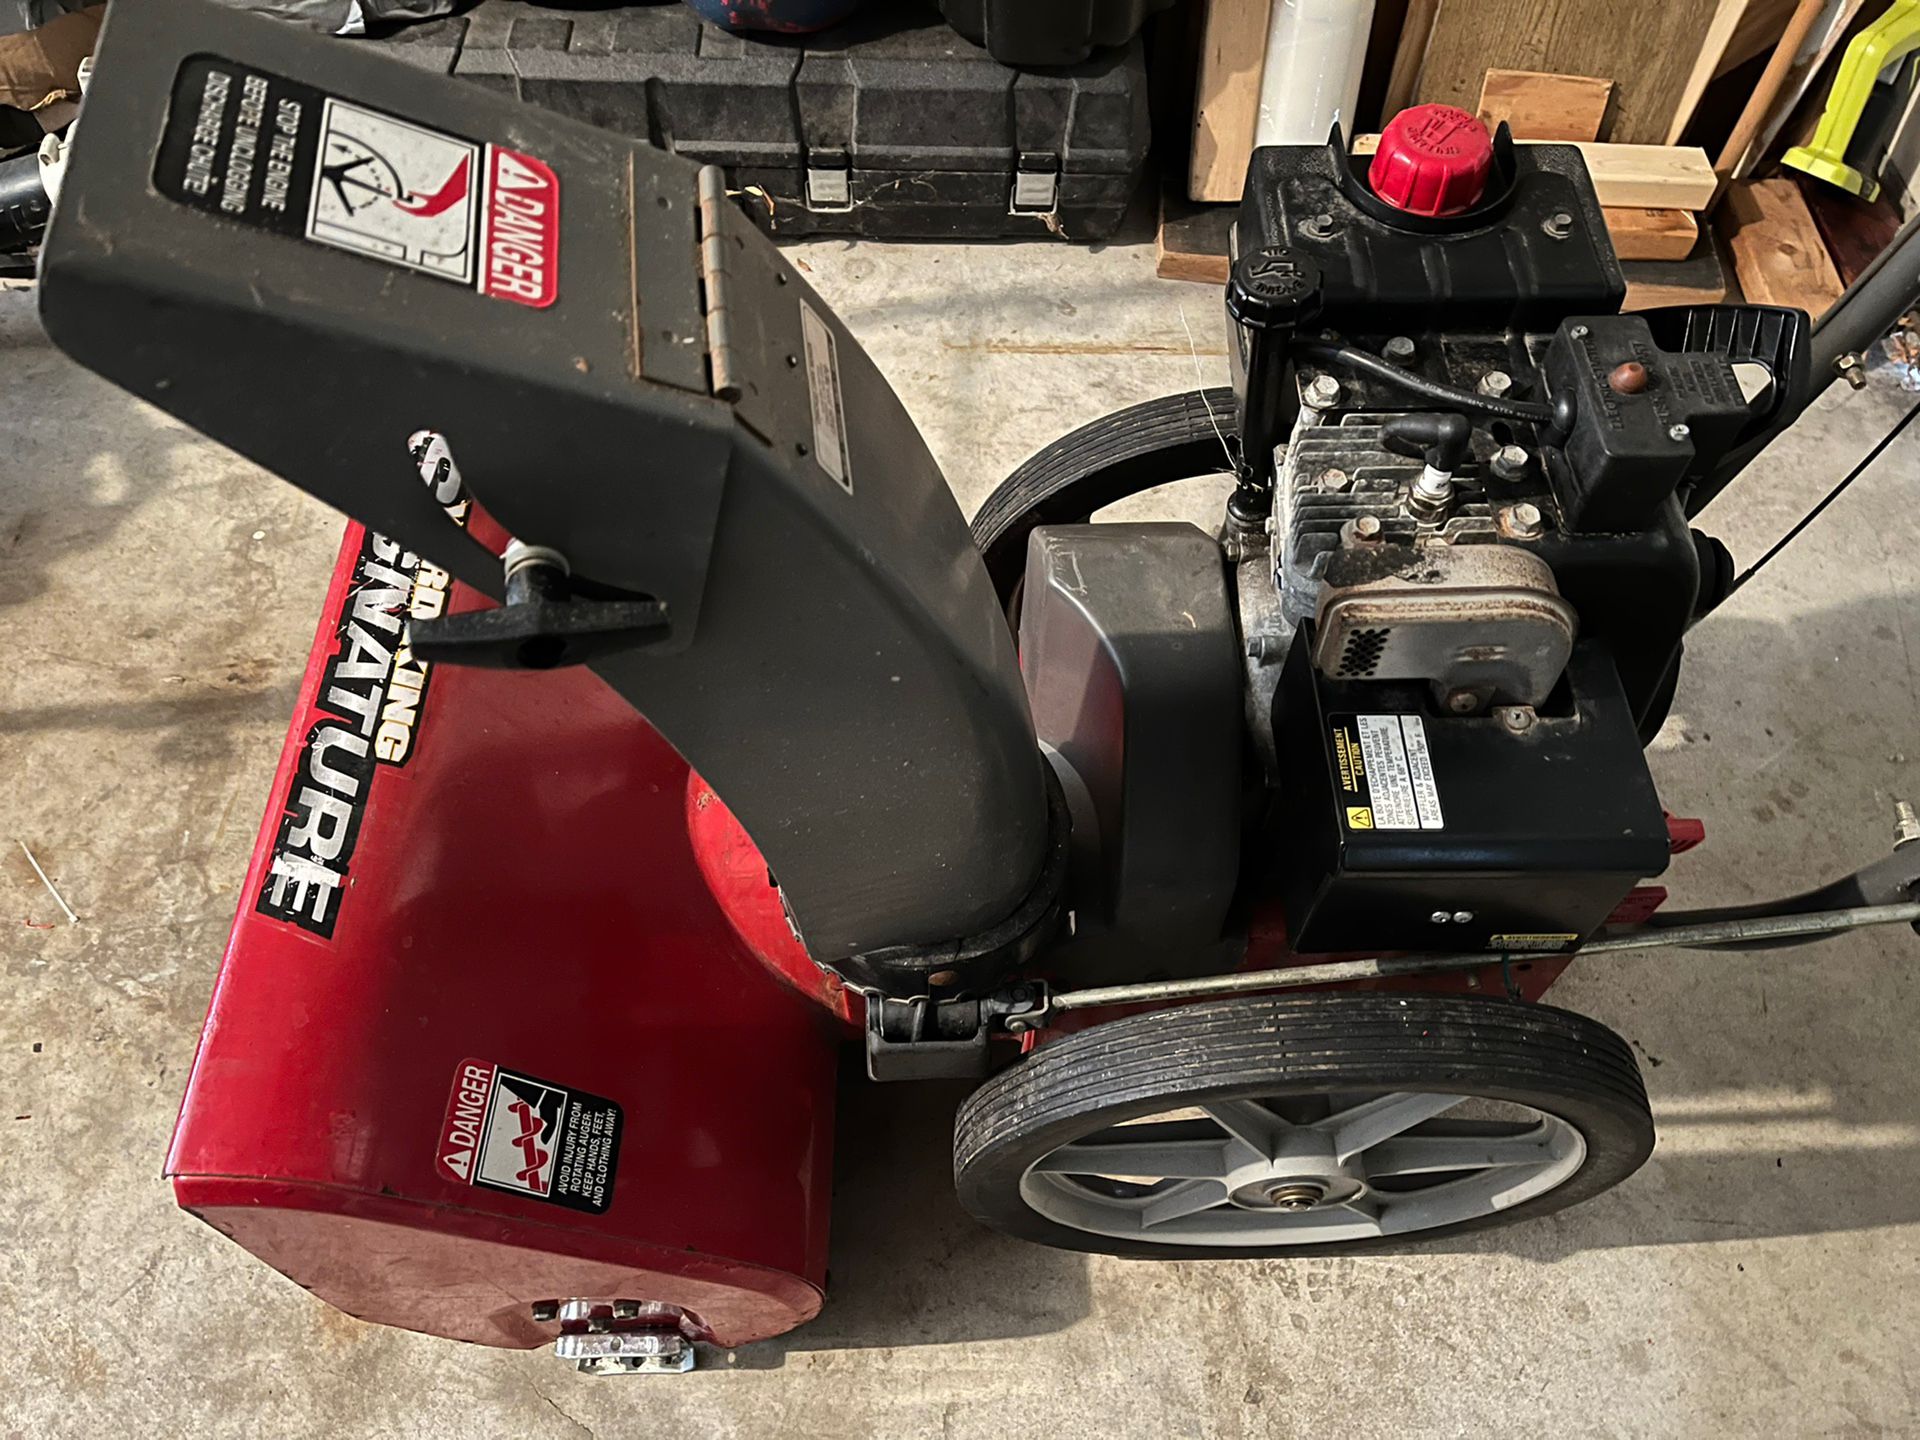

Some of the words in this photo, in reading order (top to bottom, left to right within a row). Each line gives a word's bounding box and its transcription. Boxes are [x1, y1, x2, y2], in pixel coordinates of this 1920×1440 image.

[193, 71, 232, 146] DISCHARGE
[238, 74, 268, 128] BEFORE
[275, 98, 302, 135] STOP
[270, 134, 297, 162] THE
[183, 143, 215, 195] CHUTE
[220, 126, 258, 213] UNCLOGGING
[261, 160, 292, 212] ENGINE
[490, 189, 545, 299] DANGER
[1359, 717, 1369, 729] LES
[1333, 728, 1353, 791] AVERTISSEMENT
[1351, 742, 1364, 776] CAUTION
[449, 1065, 490, 1148] DANGER
[569, 1101, 583, 1130] FROM
[593, 1111, 606, 1138] FEET,
[604, 1108, 617, 1138] AWAY!
[563, 1129, 579, 1164] INJURY
[587, 1138, 600, 1173] HANDS,
[596, 1137, 613, 1187] CLOTHING
[557, 1163, 573, 1194] AVOID
[570, 1145, 587, 1192] ROTATING
[582, 1172, 594, 1197] KEEP
[592, 1187, 605, 1207] AND
